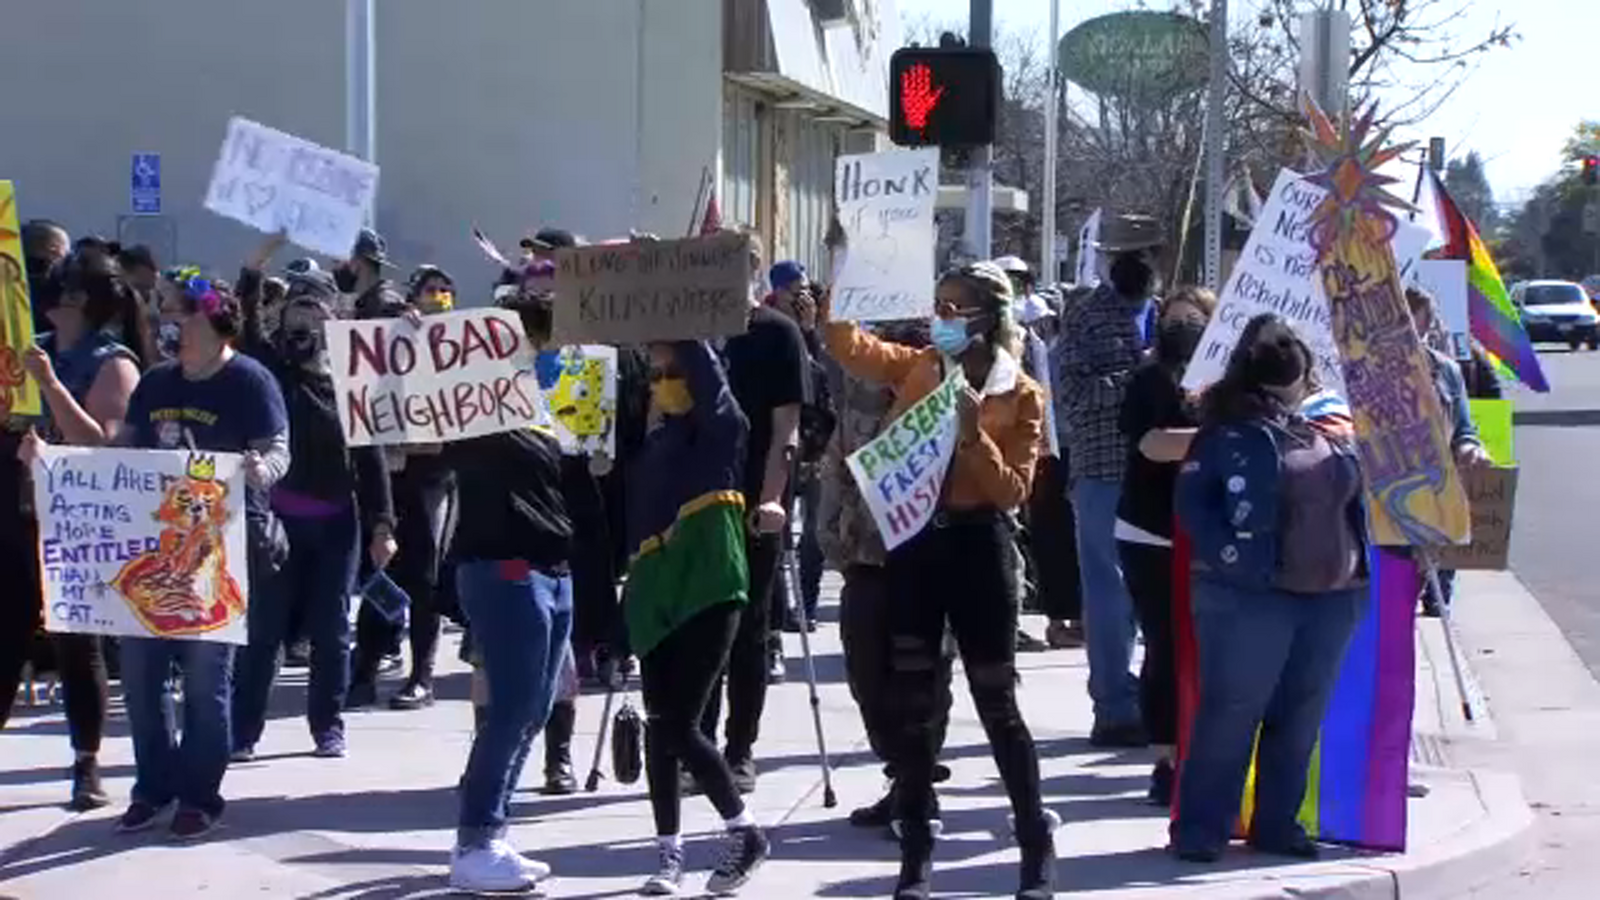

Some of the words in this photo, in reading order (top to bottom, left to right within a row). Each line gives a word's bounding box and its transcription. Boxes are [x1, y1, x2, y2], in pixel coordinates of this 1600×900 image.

[842, 161, 931, 201] HONK
[348, 326, 416, 376] NO
[428, 317, 520, 373] BAD
[346, 370, 536, 438] NEIGHBORS
[112, 463, 157, 494] ARE
[50, 493, 131, 522] ACTING
[55, 521, 114, 541] MORE
[43, 537, 161, 565] ENTITLED
[62, 585, 86, 600] MY
